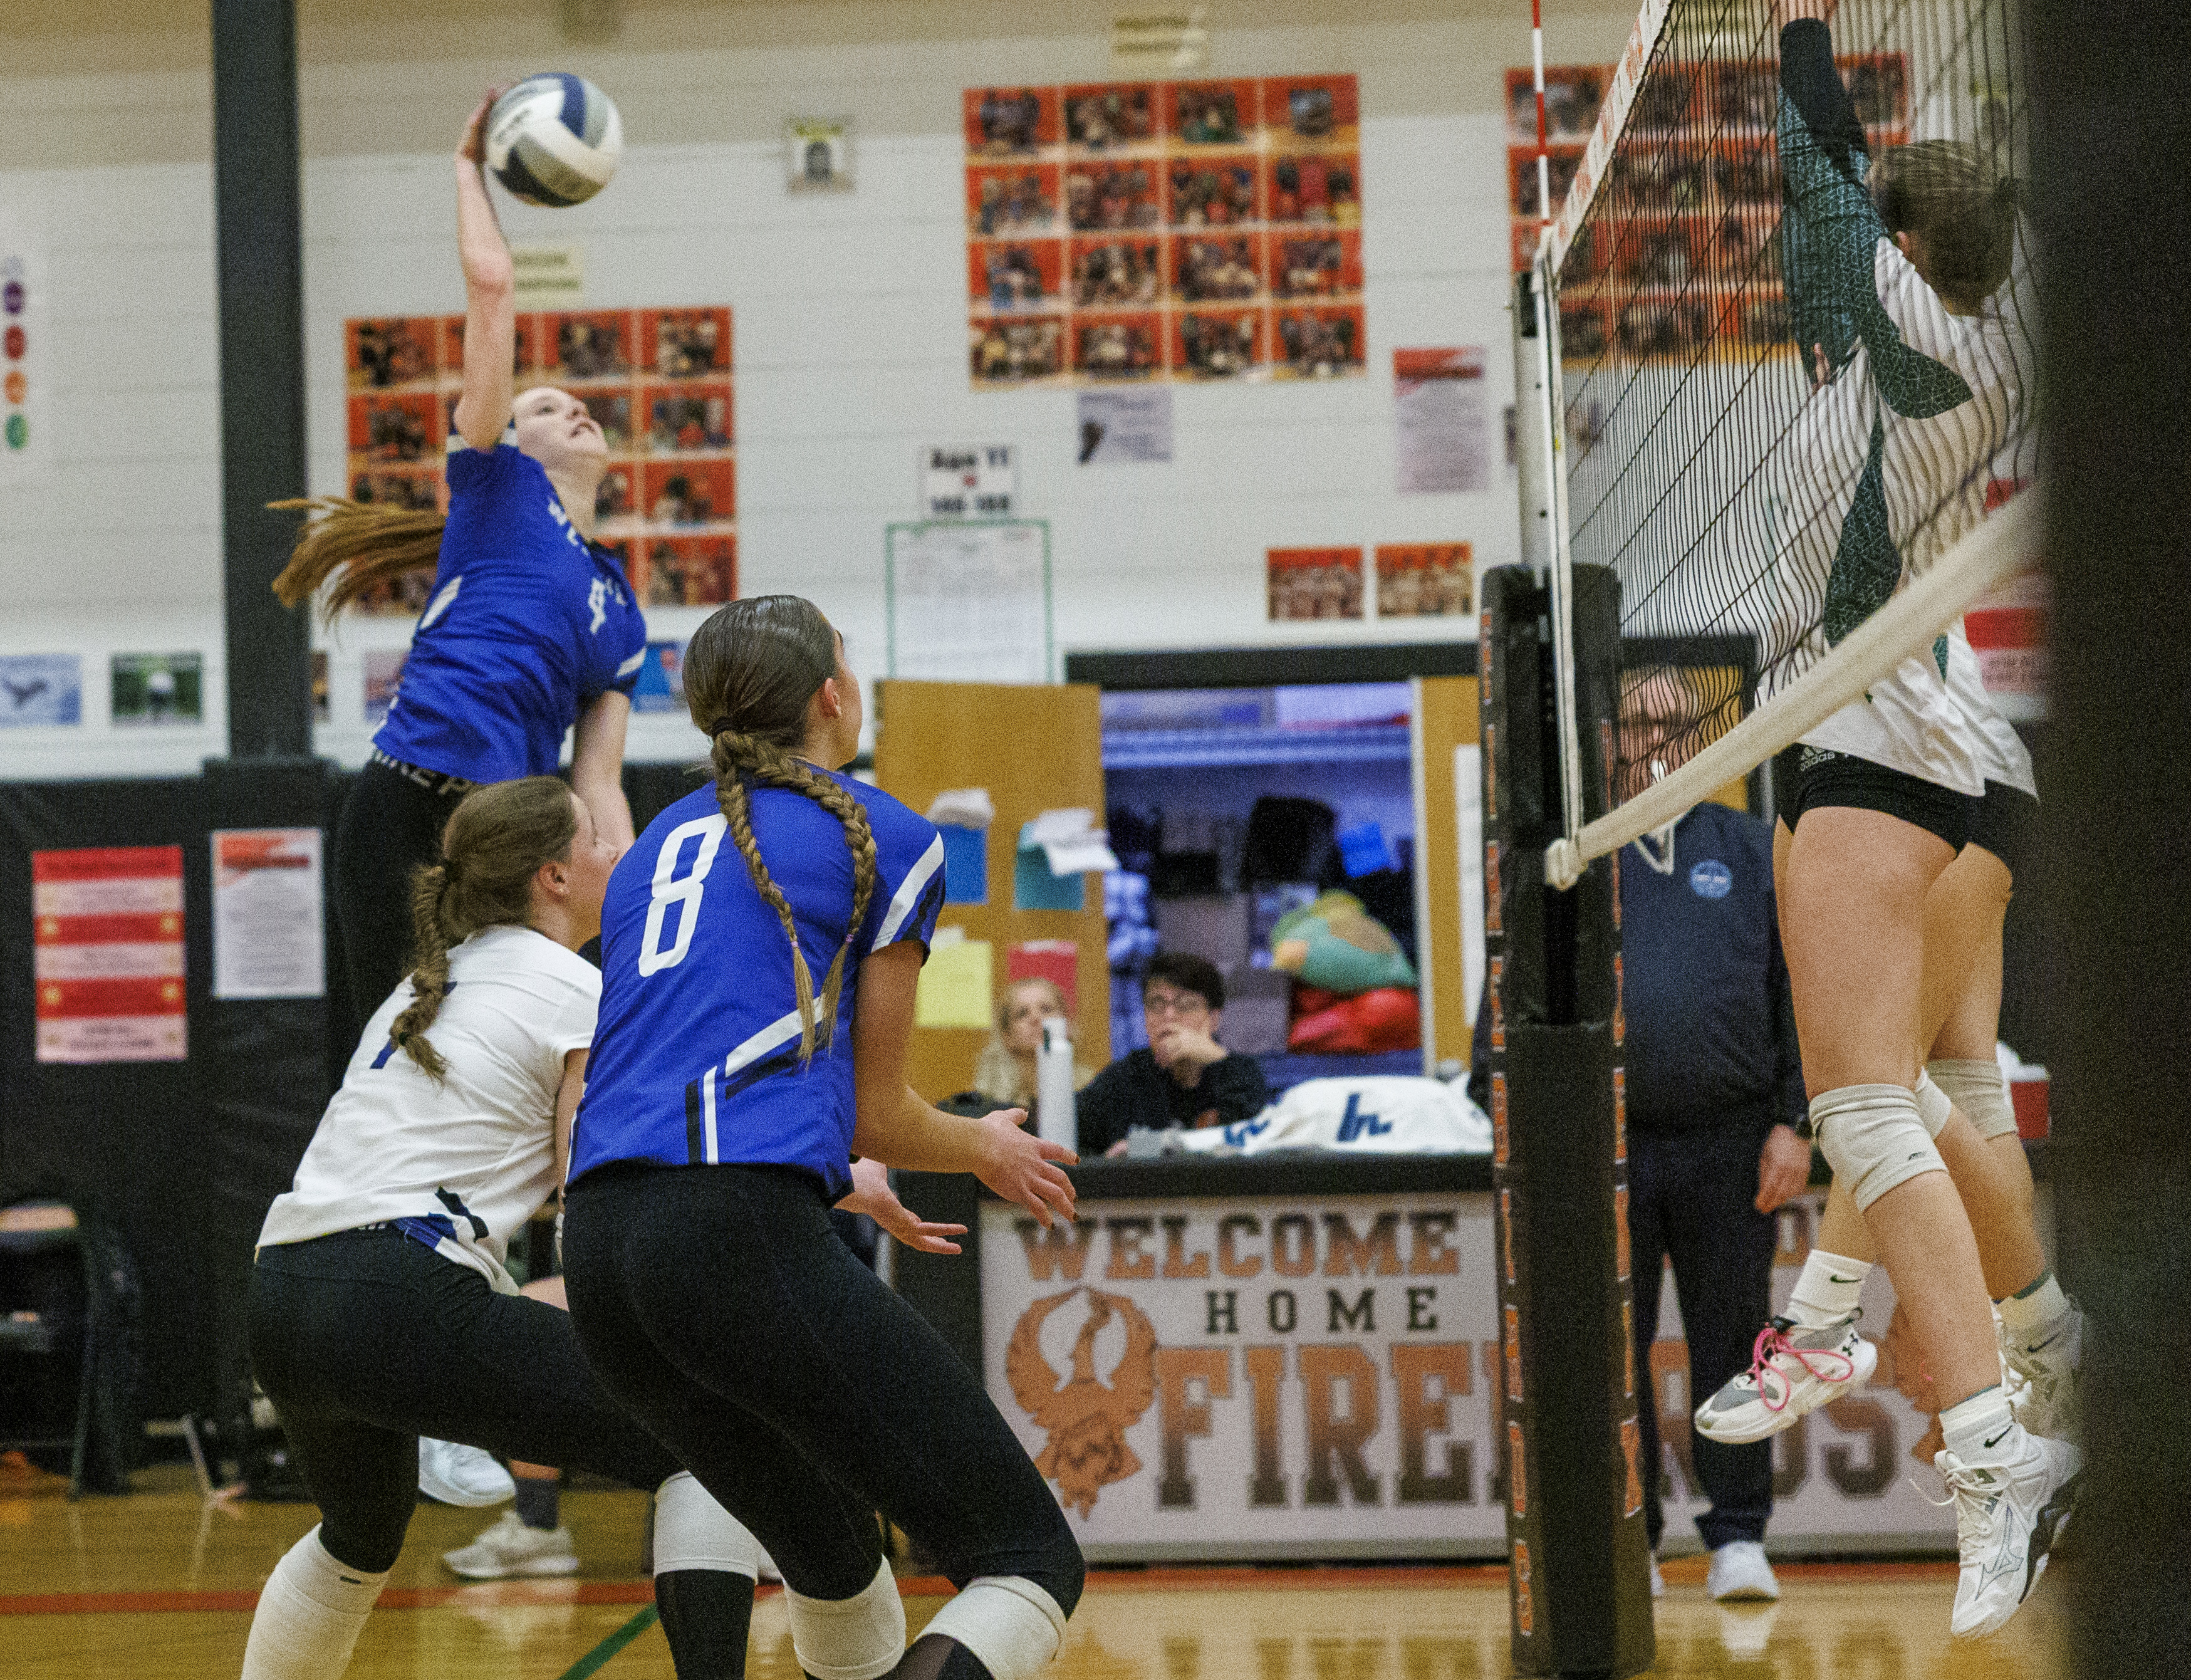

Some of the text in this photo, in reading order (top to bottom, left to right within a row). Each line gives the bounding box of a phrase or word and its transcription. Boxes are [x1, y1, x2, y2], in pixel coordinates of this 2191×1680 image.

[638, 812, 728, 978] 8
[1014, 1210, 1460, 1280] WELCOME
[1205, 1286, 1439, 1333] HOME
[1155, 1332, 1902, 1511] FIRERS
